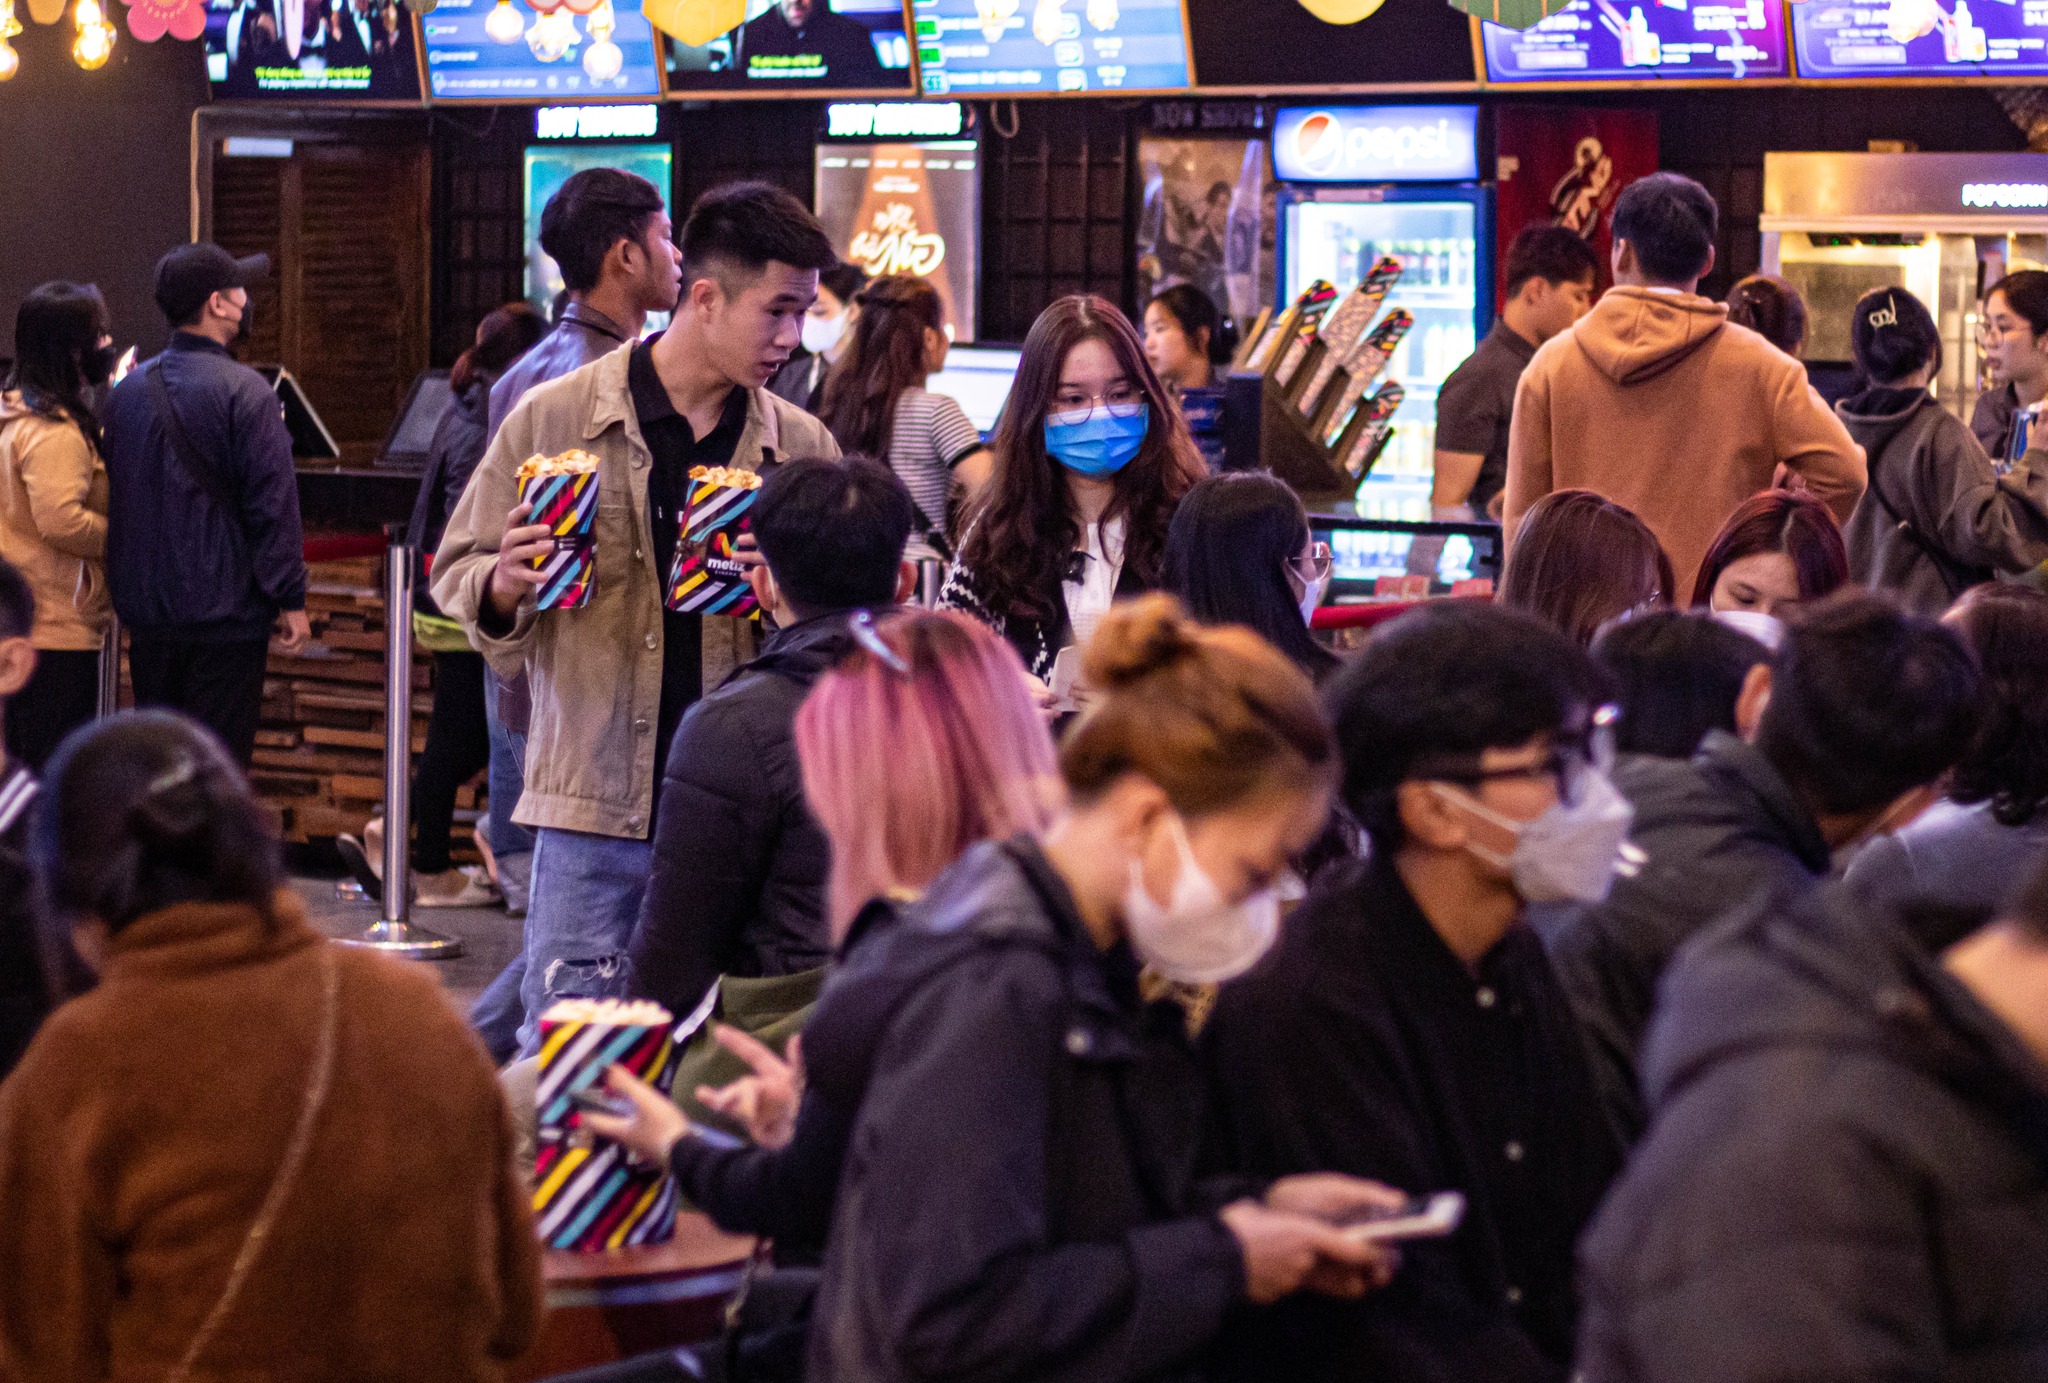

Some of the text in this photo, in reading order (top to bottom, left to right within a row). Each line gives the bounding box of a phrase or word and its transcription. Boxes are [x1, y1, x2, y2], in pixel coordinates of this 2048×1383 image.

[1345, 118, 1450, 168] pepsi
[1962, 183, 2048, 208] POPCORN
[707, 557, 745, 572] metiz
